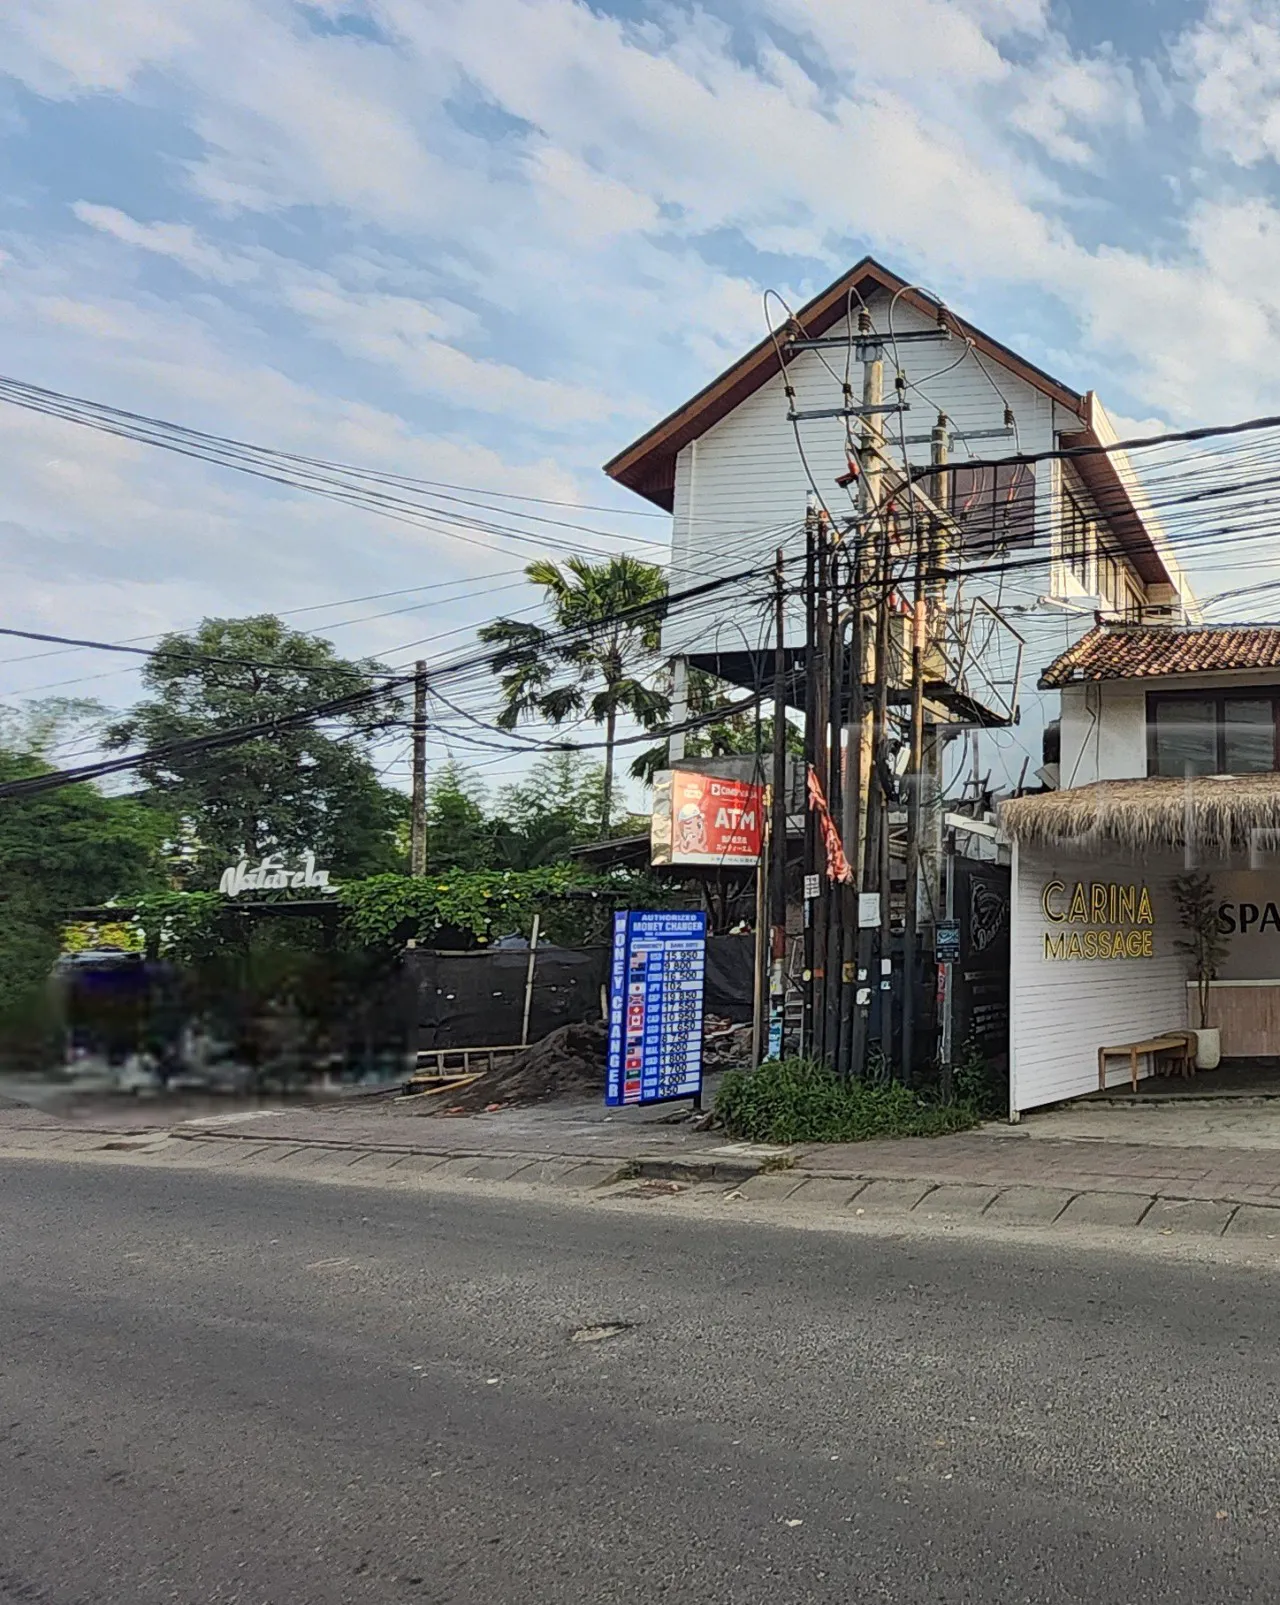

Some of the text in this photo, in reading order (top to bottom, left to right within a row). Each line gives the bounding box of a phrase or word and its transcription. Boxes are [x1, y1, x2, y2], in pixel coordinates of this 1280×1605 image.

[714, 807, 755, 832] ATM
[1042, 880, 1154, 925] CARINA
[632, 921, 703, 932] MONEY CHANGER
[1042, 930, 1154, 961] MASSAGE
[665, 982, 682, 990] 102
[608, 919, 626, 1098] MONEY CHANGER
[661, 1086, 678, 1095] 350
